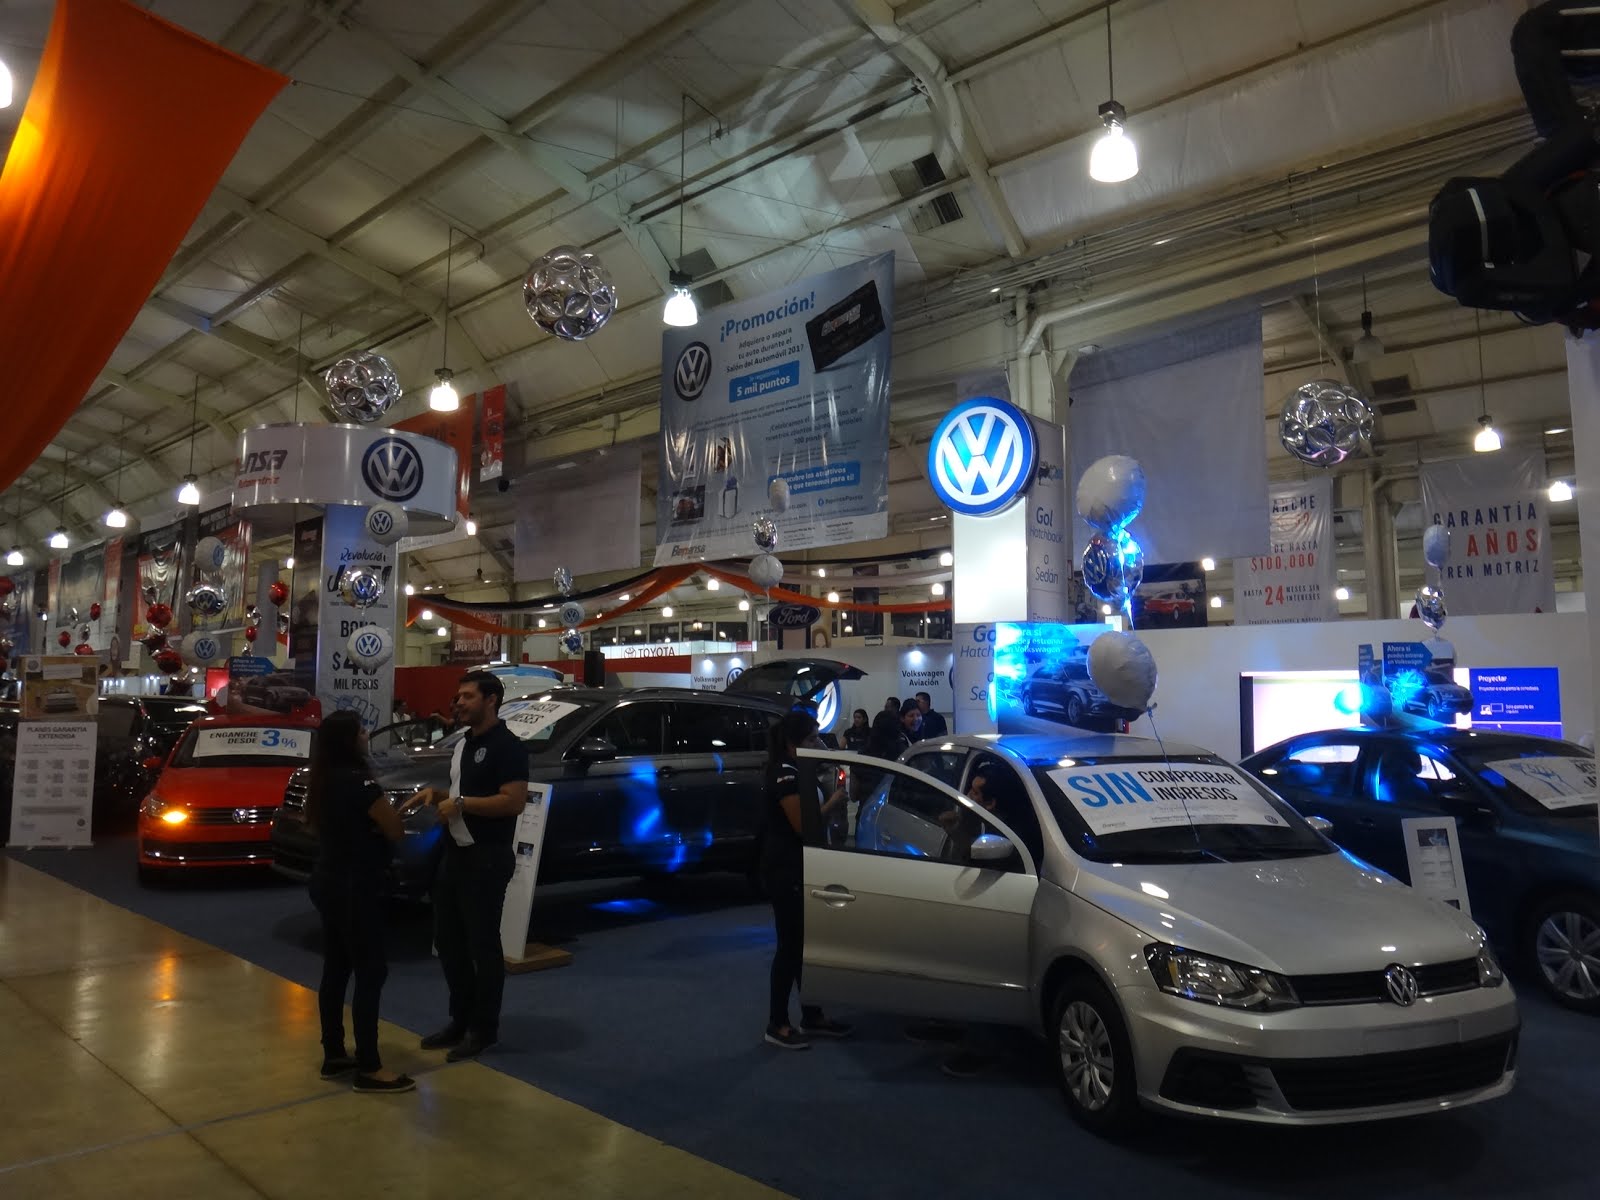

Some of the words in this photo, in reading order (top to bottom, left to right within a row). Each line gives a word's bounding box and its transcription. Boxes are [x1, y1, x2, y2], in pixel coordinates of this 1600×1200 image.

[720, 291, 815, 342] ¡Promoción!
[726, 363, 744, 374] Salón
[744, 360, 754, 369] del
[754, 348, 787, 365] Automóvil
[788, 343, 805, 355] 2017
[745, 349, 760, 358] auto
[761, 341, 786, 353] durante
[736, 386, 743, 397] 5
[744, 382, 758, 395] mil
[759, 375, 791, 393] puntos
[1433, 501, 1537, 528] GARANTÍA
[1466, 527, 1538, 557] AÑOS
[1251, 552, 1316, 573] $100,000
[1483, 559, 1539, 577] MOTRIZ
[1035, 566, 1058, 585] Sedán
[1264, 585, 1285, 606] 24
[778, 607, 810, 625] Ford
[973, 624, 996, 643] Go
[638, 646, 675, 658] TOYOTA
[960, 645, 995, 658] Hatch
[693, 676, 724, 684] Volkswagen
[901, 670, 945, 678] Volkswagen
[909, 678, 939, 687] Aviación
[1478, 675, 1507, 683] Proyectar
[333, 678, 349, 690] MIL
[351, 678, 379, 690] PESOS
[210, 731, 259, 739] ENGANCHE
[227, 737, 257, 745] DESDE
[1067, 771, 1154, 808] SIN
[1137, 770, 1242, 786] COMPROBAR
[1152, 786, 1239, 801] INGRESOS
